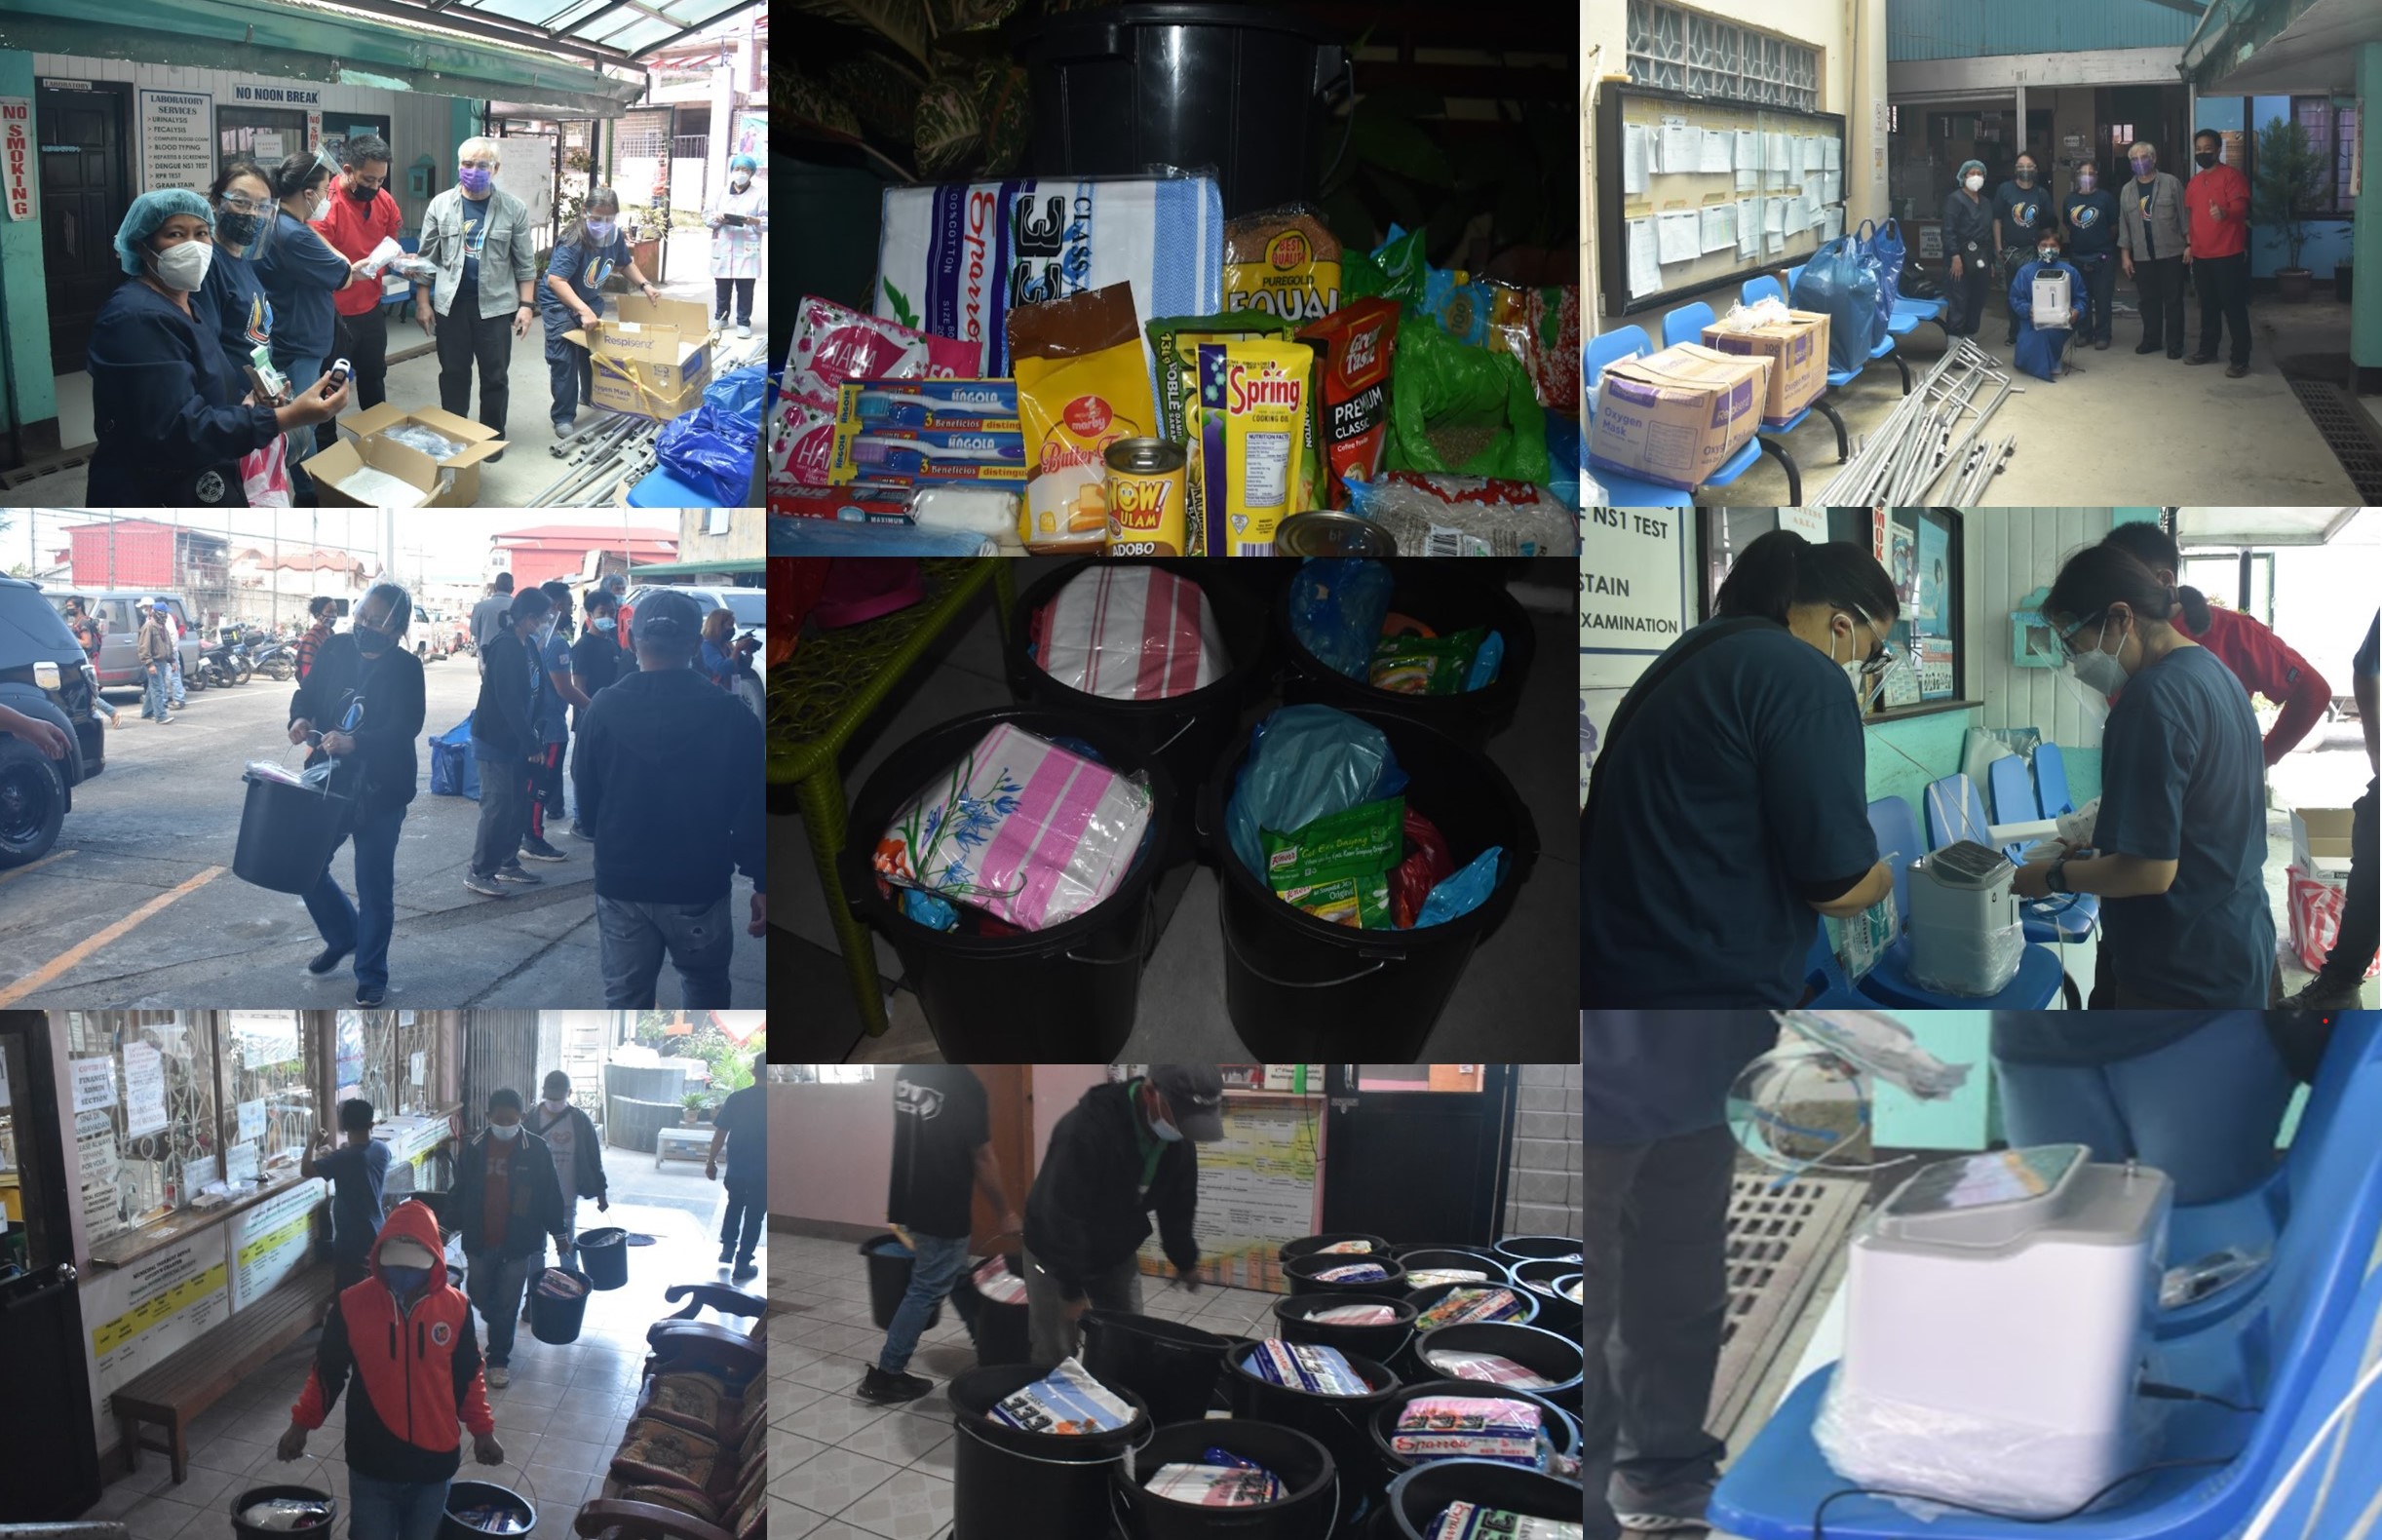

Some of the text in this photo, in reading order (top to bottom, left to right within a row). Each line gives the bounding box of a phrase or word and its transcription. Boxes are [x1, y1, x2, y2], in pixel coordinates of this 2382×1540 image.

[150, 95, 204, 105] LABORATORY
[236, 86, 319, 104] NO NOON BREAK
[3, 105, 27, 120] NO
[158, 105, 198, 115] SERVICES
[309, 115, 320, 125] NO
[7, 124, 27, 215] SMOKING
[1279, 237, 1301, 250] BEST
[1272, 250, 1307, 265] QUALITY
[964, 191, 995, 343] Sparro
[1262, 276, 1315, 288] PUREGOLD
[604, 334, 652, 349] Respisenz
[1229, 365, 1301, 415] Spring
[1334, 386, 1383, 425] PREMIUM
[925, 412, 980, 428] 3 Beneficios
[1071, 417, 1106, 430] marby
[1251, 414, 1279, 423] COOKING
[1604, 406, 1643, 429] Oxygen
[1335, 417, 1371, 440] CLASSIC
[1601, 419, 1627, 437] Mask
[1337, 442, 1356, 452] Coffee
[920, 458, 976, 475] 3 Beneficios
[1121, 513, 1157, 527] ULAM
[1594, 507, 1668, 539] NS1 TEST
[1112, 541, 1156, 557] ADOBO
[1271, 852, 1296, 866] Knorr
[79, 1074, 106, 1085] FINANCE
[84, 1085, 105, 1094] ADMIN
[81, 1095, 108, 1105] SECTION
[1396, 1436, 1473, 1453] Sparrow
